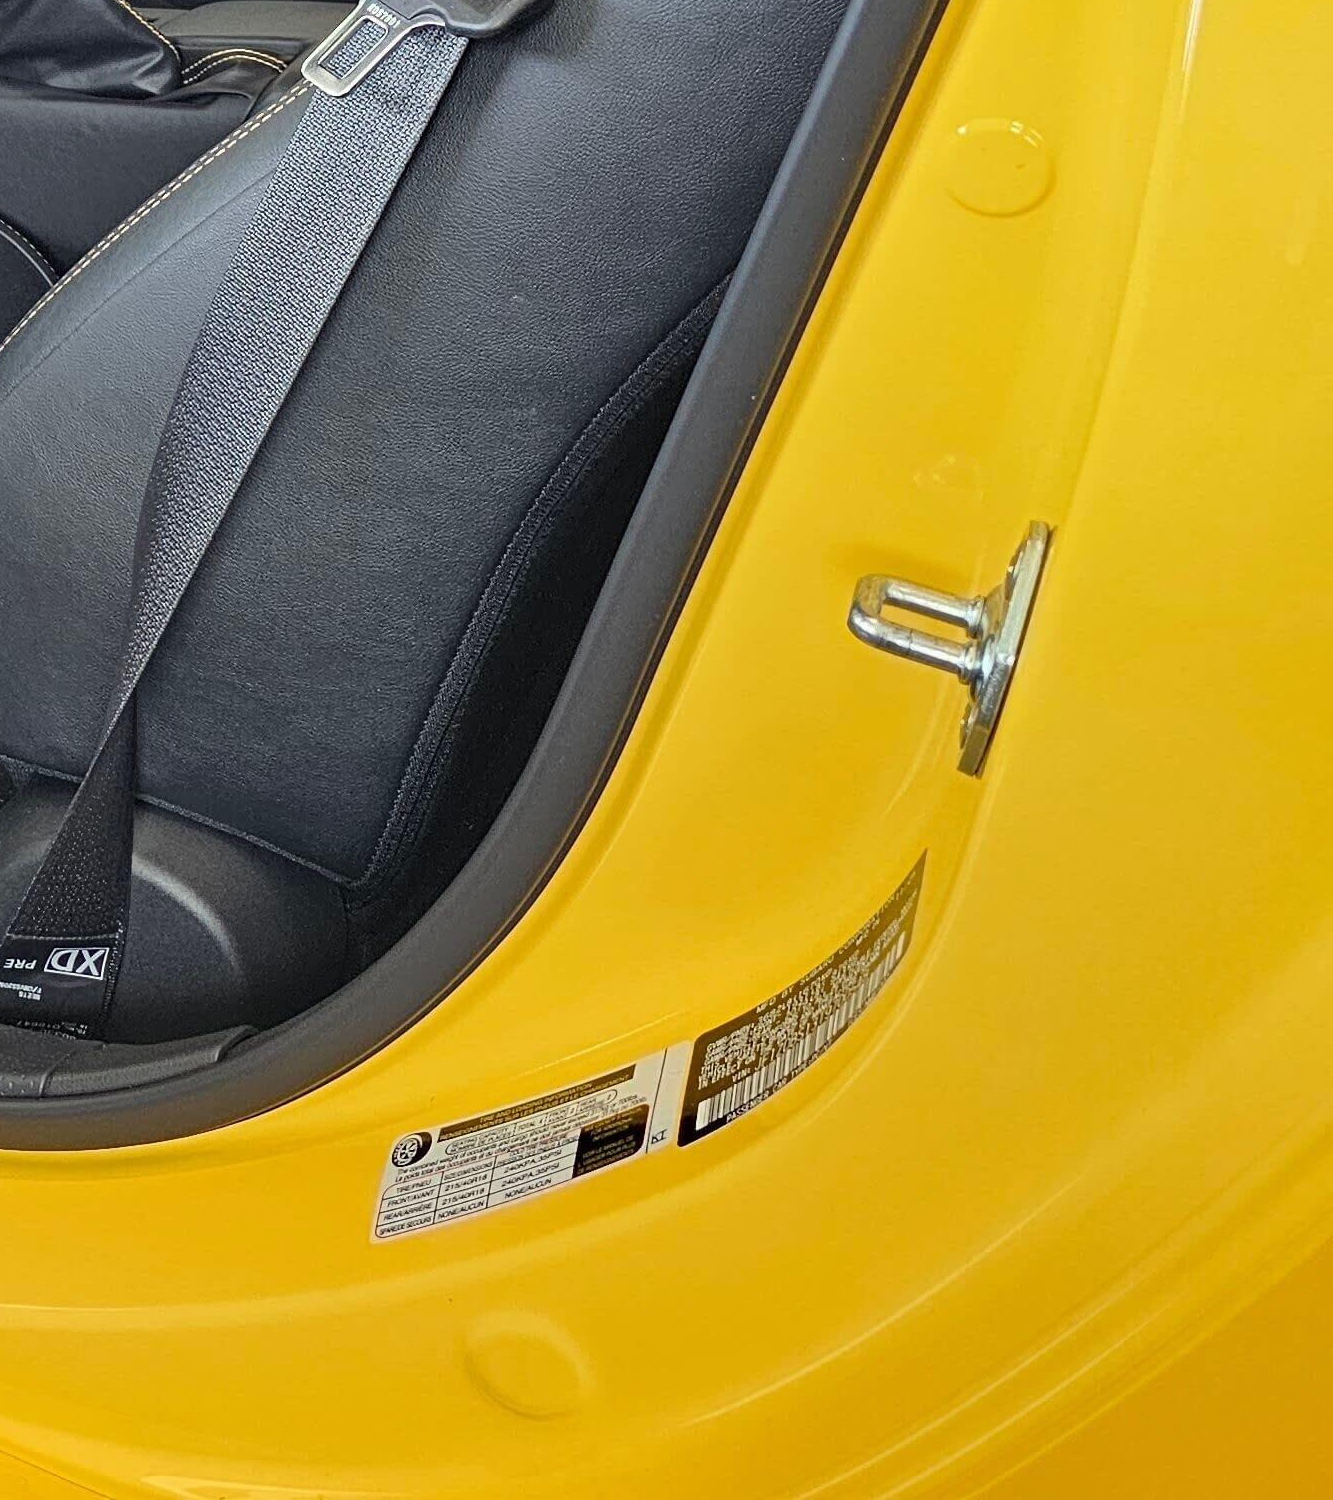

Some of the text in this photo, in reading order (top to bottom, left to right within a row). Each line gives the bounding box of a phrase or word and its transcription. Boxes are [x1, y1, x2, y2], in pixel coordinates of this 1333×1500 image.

[3, 949, 105, 976] XD PRE
[444, 1173, 487, 1192] 215/40R18
[441, 1186, 485, 1205] 215/40R18
